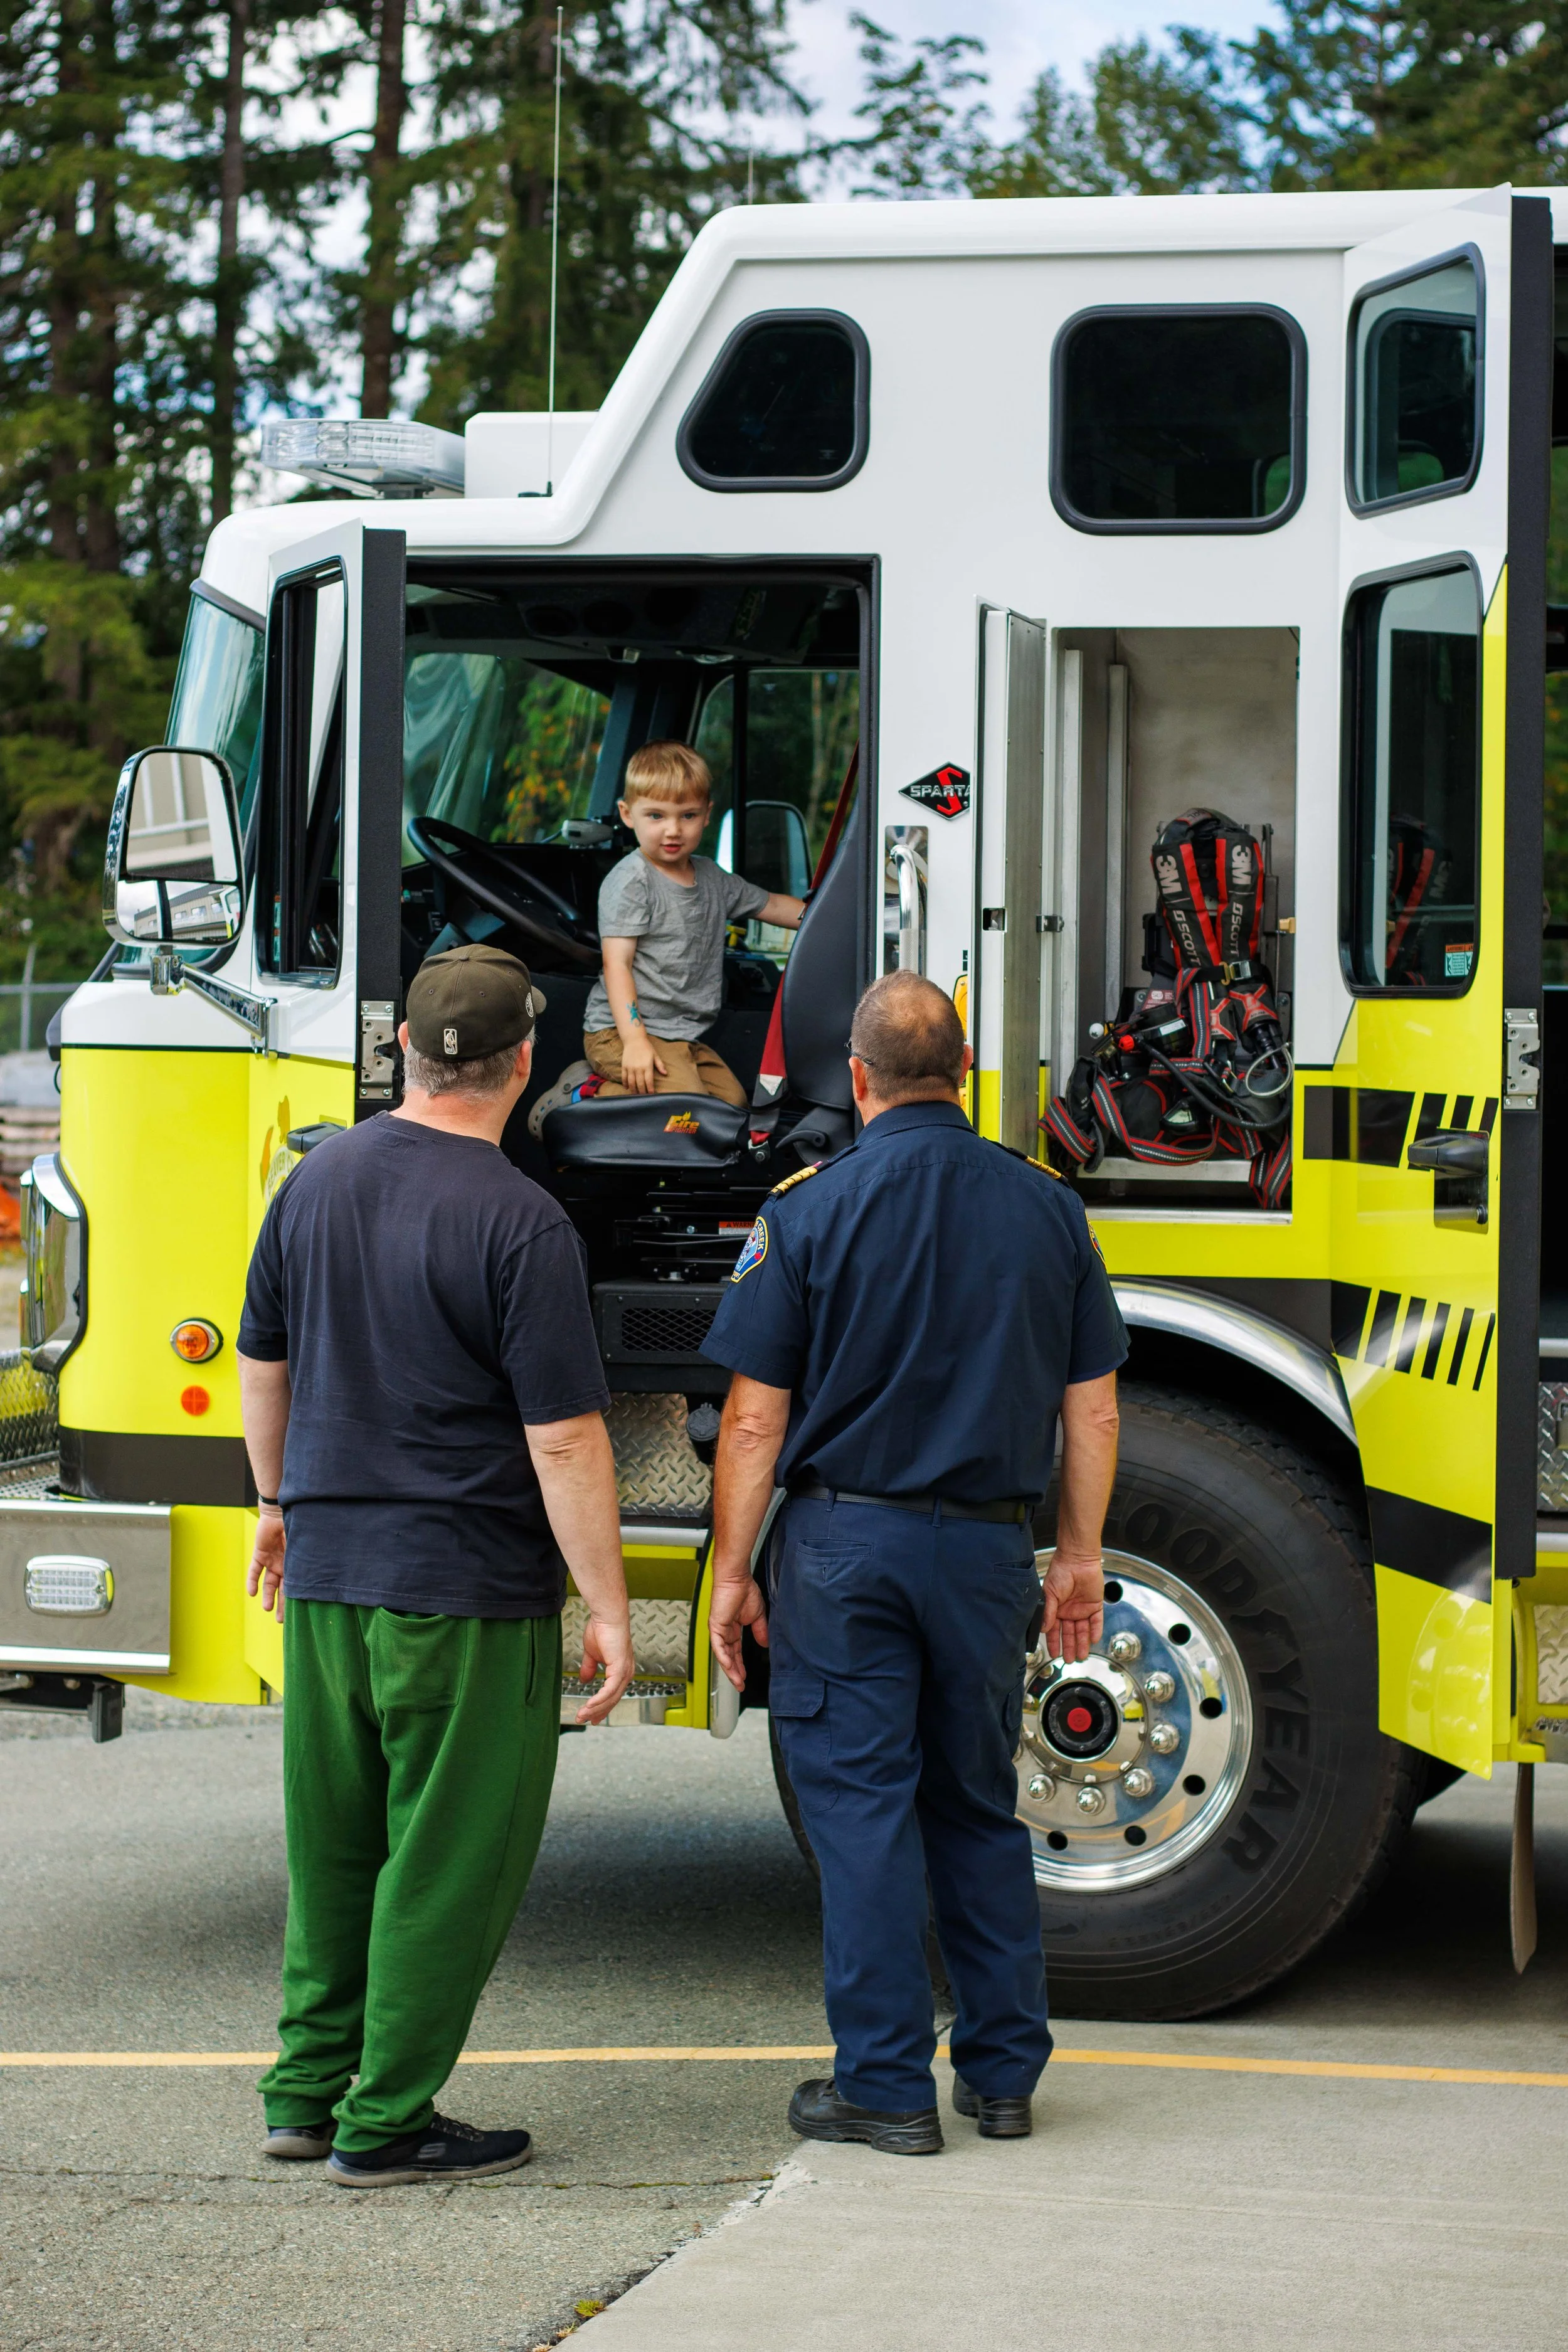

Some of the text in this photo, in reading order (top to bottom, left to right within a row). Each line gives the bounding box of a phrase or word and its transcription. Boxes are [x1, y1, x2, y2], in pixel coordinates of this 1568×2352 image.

[1155, 855, 1202, 967] 3M SCOTT
[1230, 845, 1253, 958] 3M SCOTT
[663, 1111, 700, 1133] Fire
[672, 1126, 697, 1135] FIGHTER
